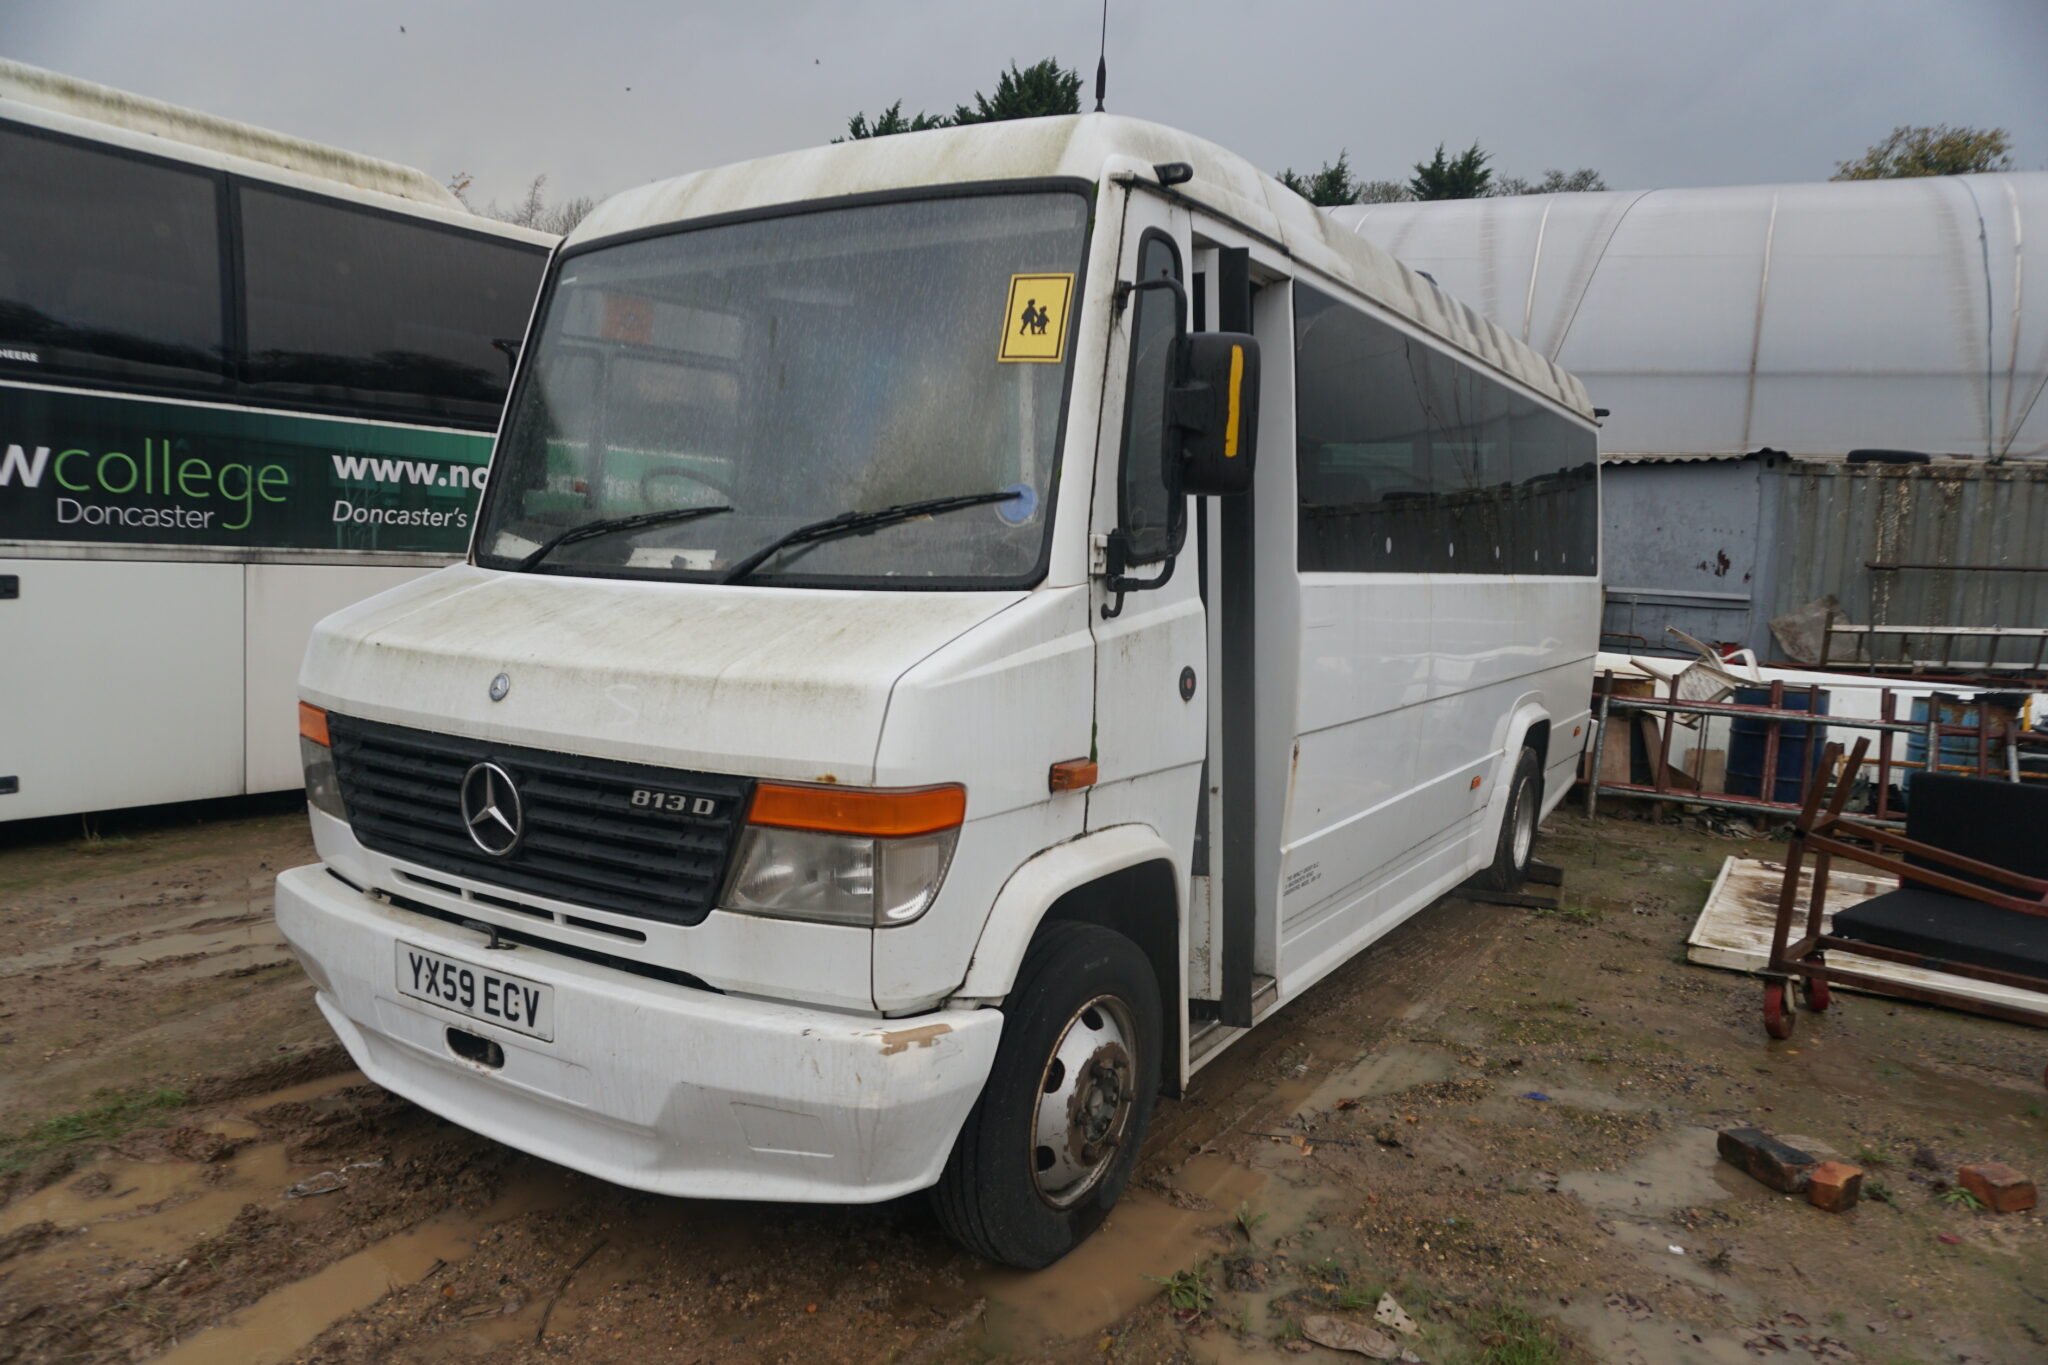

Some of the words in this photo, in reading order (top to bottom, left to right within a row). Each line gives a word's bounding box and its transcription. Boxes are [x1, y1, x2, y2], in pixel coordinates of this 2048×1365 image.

[57, 497, 215, 529] Doncaster
[332, 500, 467, 528] Doncaster's
[631, 789, 686, 811] 813
[692, 797, 715, 815] D
[409, 952, 475, 1008] YX59
[484, 975, 540, 1028] ECV
